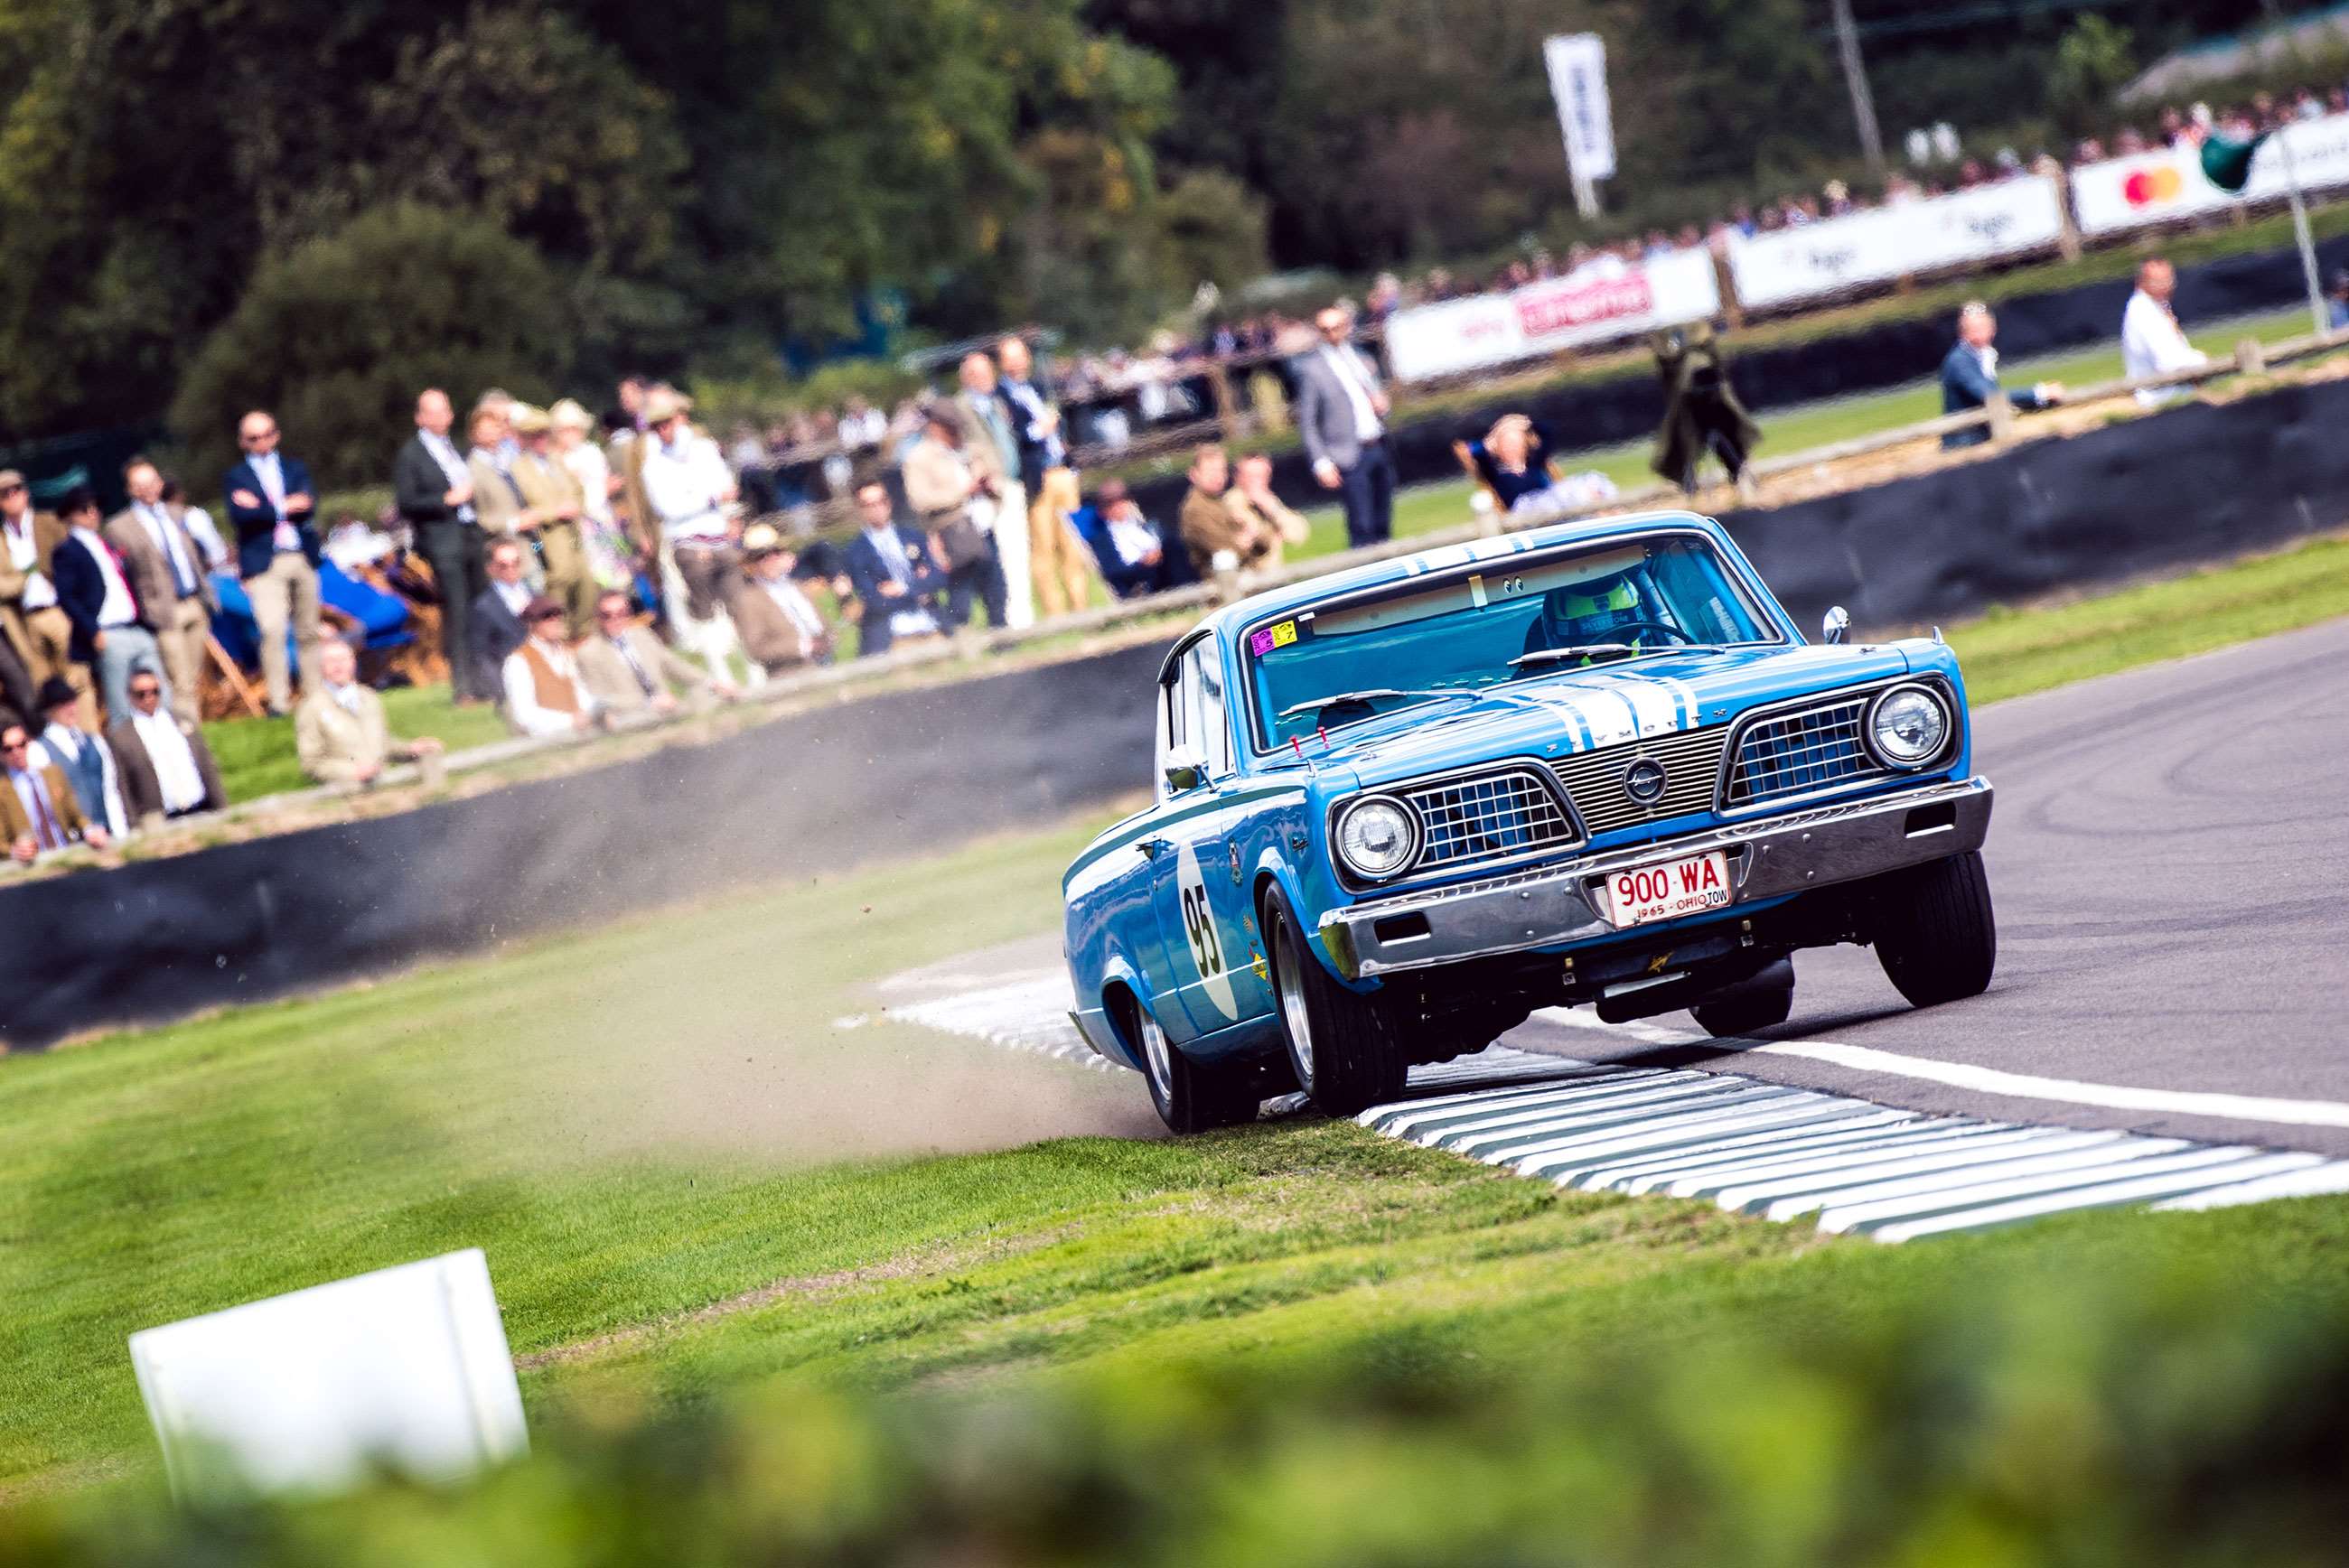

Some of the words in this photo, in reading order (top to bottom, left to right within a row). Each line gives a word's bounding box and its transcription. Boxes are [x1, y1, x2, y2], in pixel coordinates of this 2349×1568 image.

[1266, 638, 1273, 648] 5
[1287, 630, 1293, 639] 7
[1618, 869, 1669, 906] 900
[1679, 858, 1720, 893] WA
[1637, 904, 1665, 919] 1965
[1677, 894, 1707, 910] OHIO
[1708, 890, 1727, 904] TOW
[1184, 884, 1220, 978] 95
